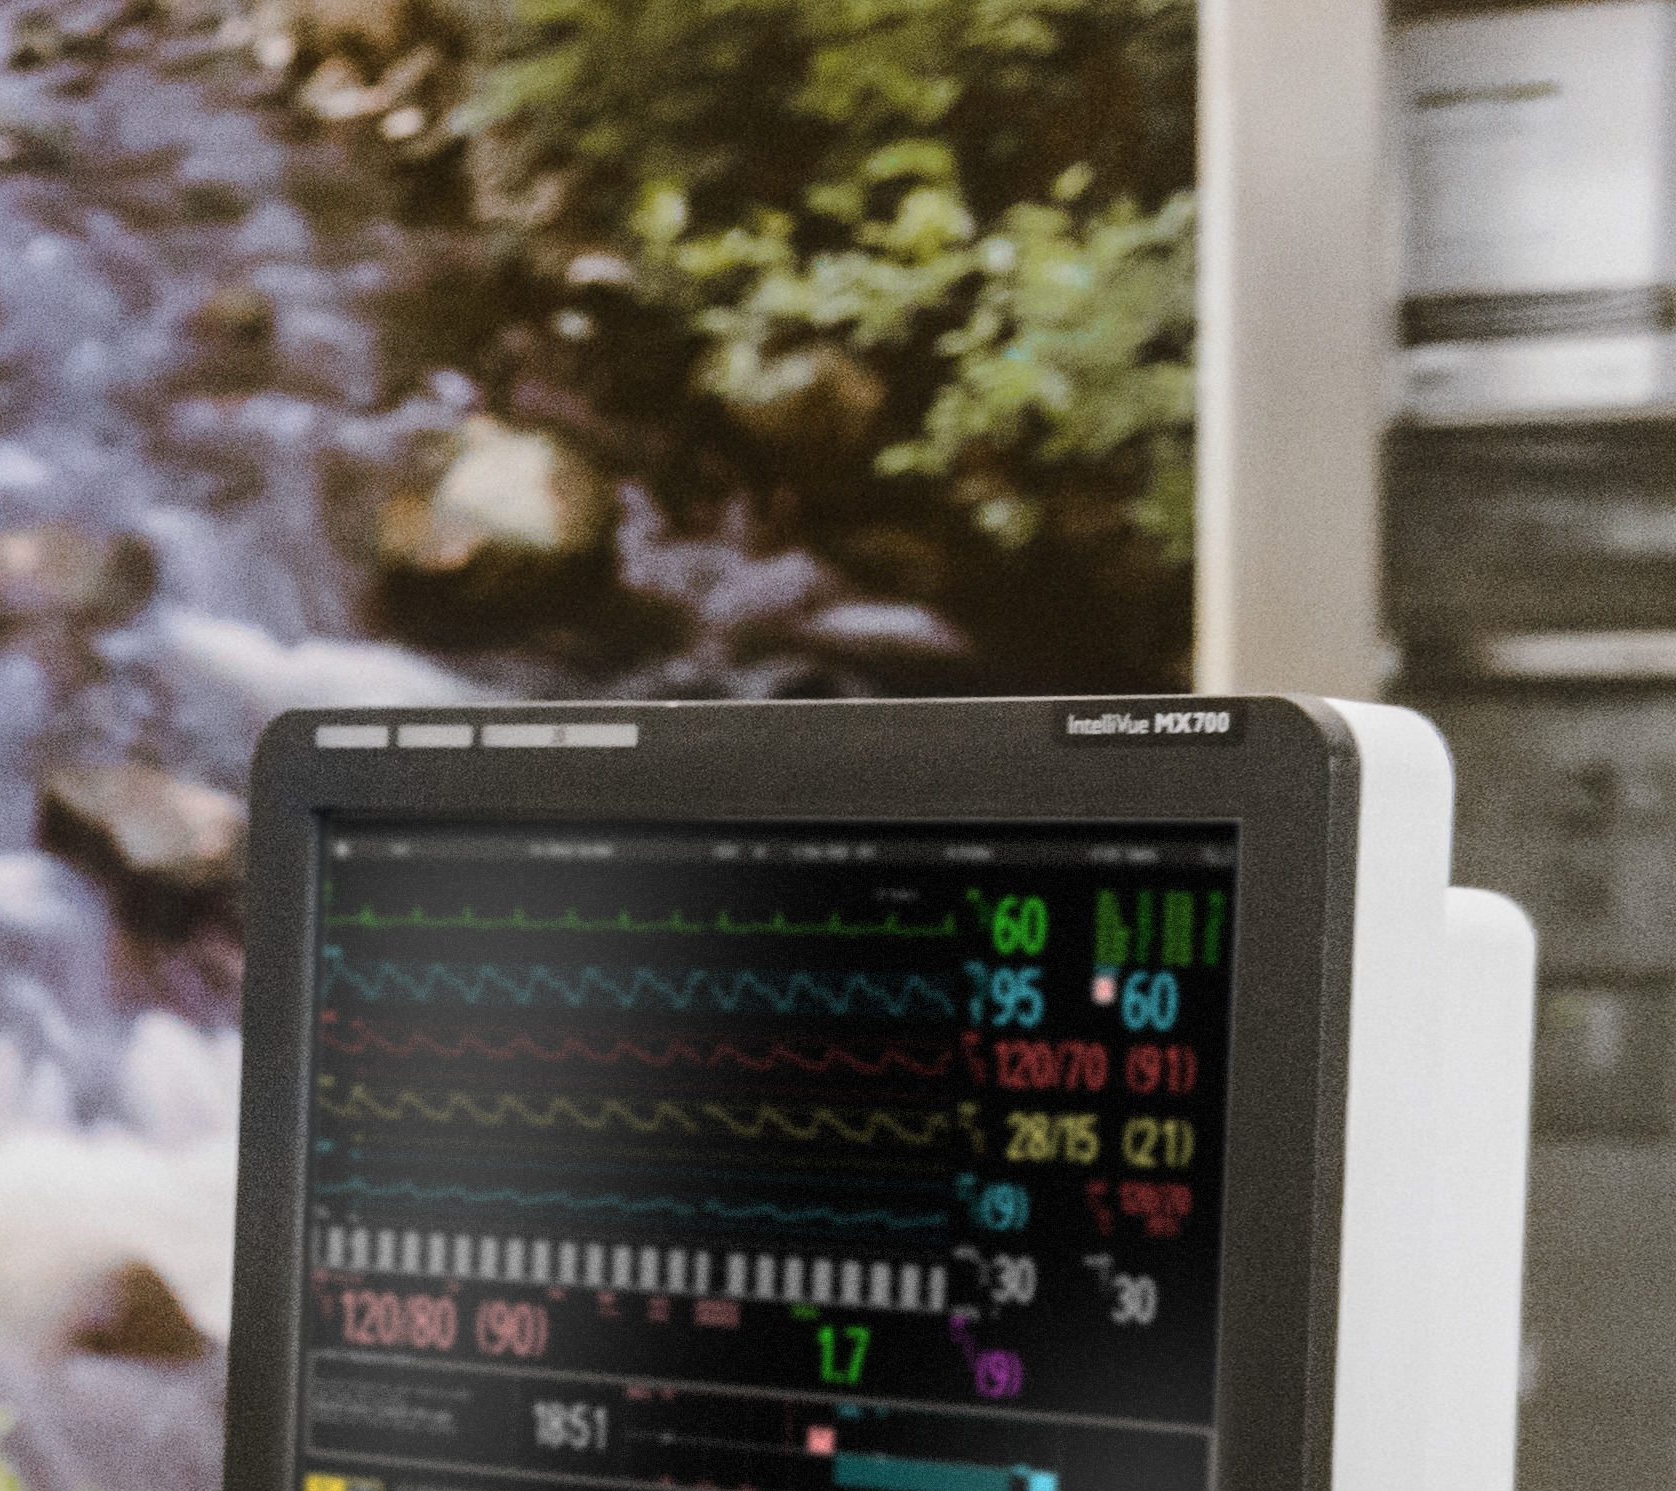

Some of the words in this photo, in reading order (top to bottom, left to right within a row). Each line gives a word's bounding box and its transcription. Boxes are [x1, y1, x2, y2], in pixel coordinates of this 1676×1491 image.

[1067, 714, 1150, 735] IntelliVue
[1154, 712, 1230, 734] MX700
[991, 895, 1049, 955] 60
[990, 966, 1045, 1028] 95
[1121, 971, 1179, 1033] 60
[993, 1037, 1109, 1093] 120/70
[1125, 1043, 1198, 1095] (91)
[1005, 1111, 1101, 1163] 28/15
[1122, 1116, 1196, 1169] (21)
[991, 1254, 1038, 1305] 30
[1111, 1273, 1158, 1326] 30
[340, 1289, 458, 1349] 120/80
[475, 1298, 550, 1358] (90)
